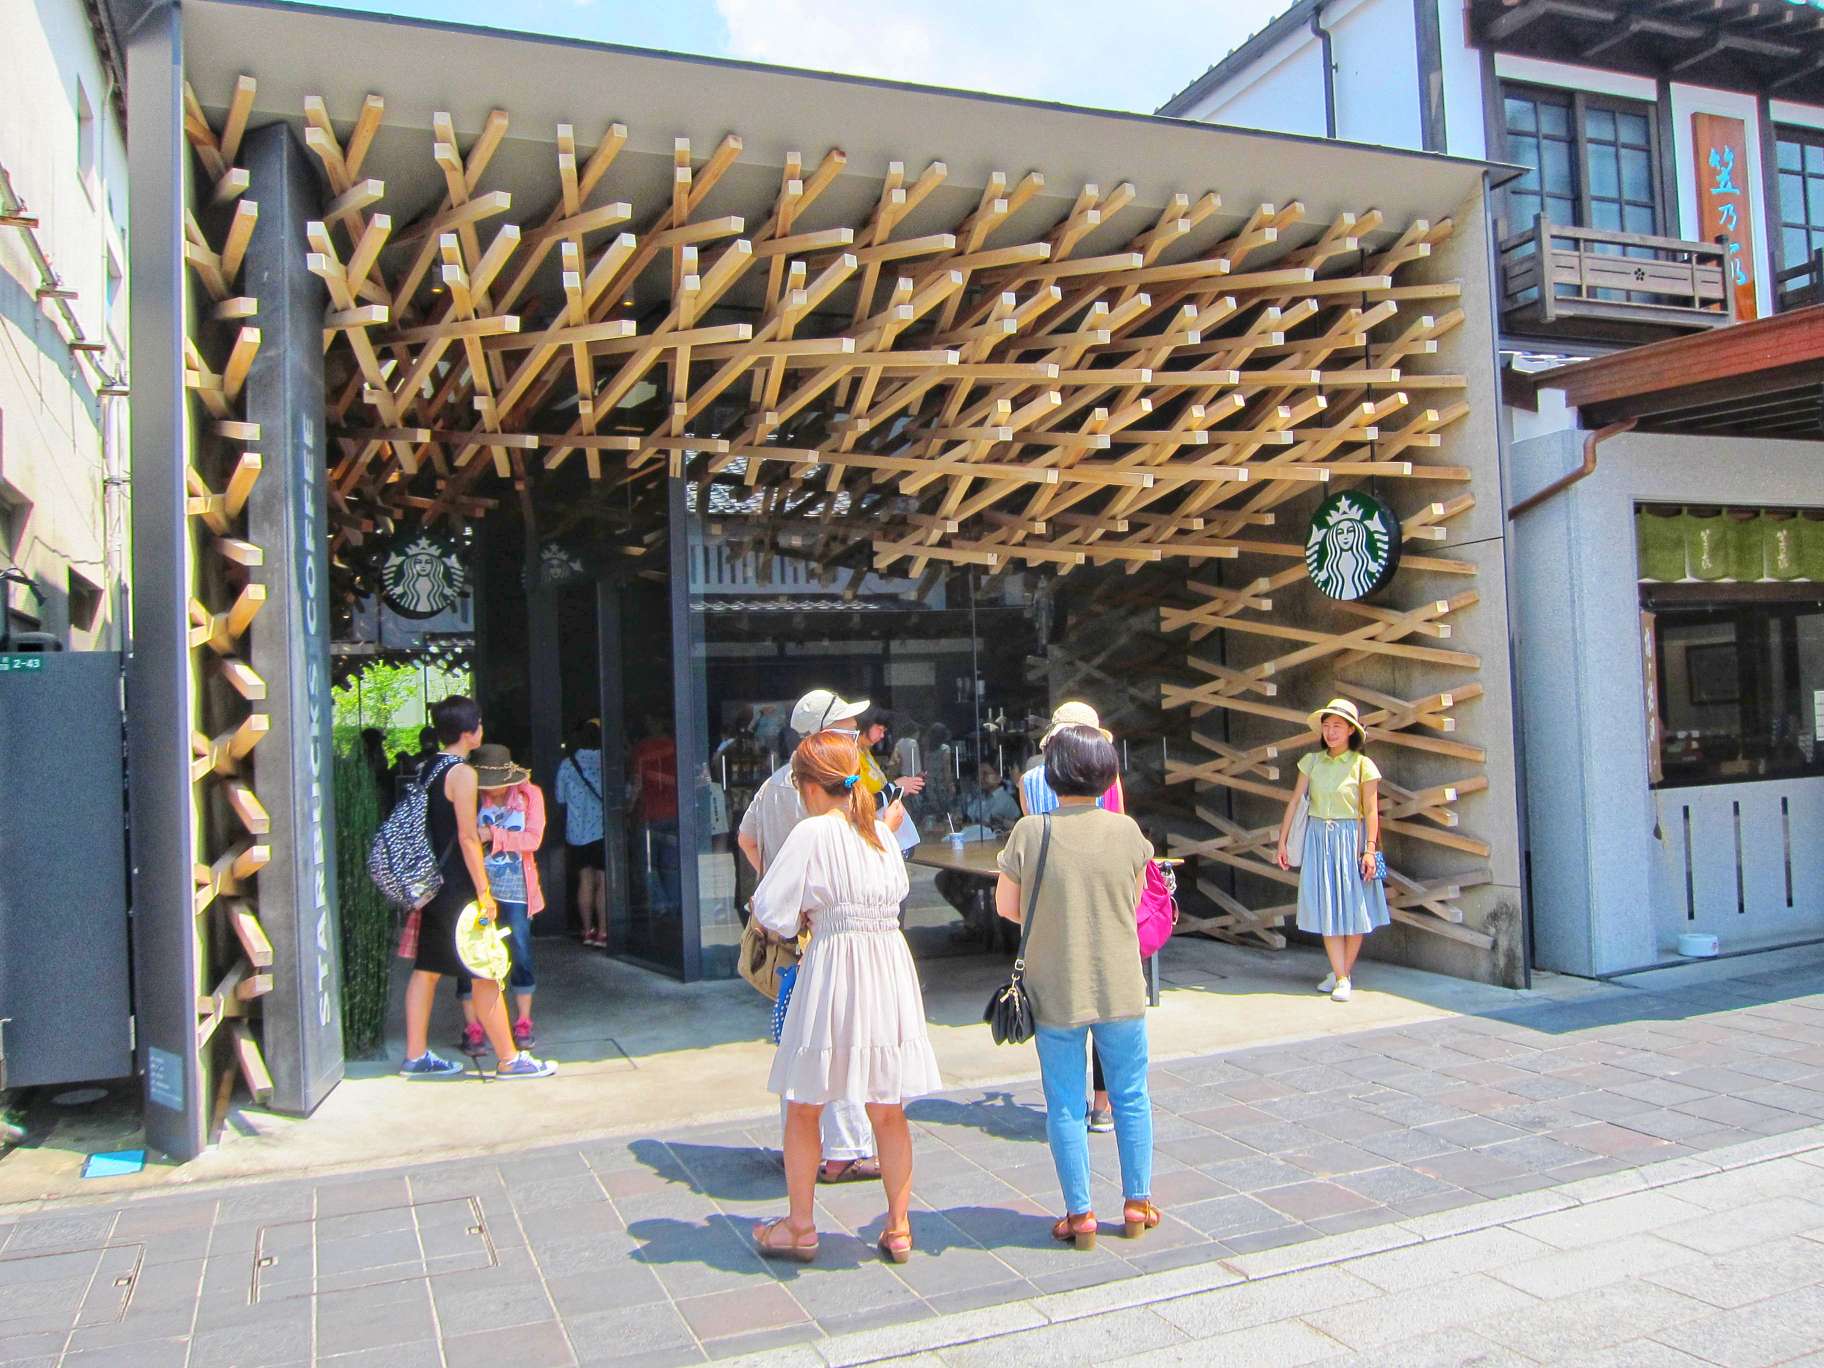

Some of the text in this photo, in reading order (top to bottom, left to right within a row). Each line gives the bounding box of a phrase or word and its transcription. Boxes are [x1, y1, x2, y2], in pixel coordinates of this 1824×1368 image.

[13, 659, 41, 669] 2-43
[302, 412, 331, 1027] STARBUCKS COFFEE
